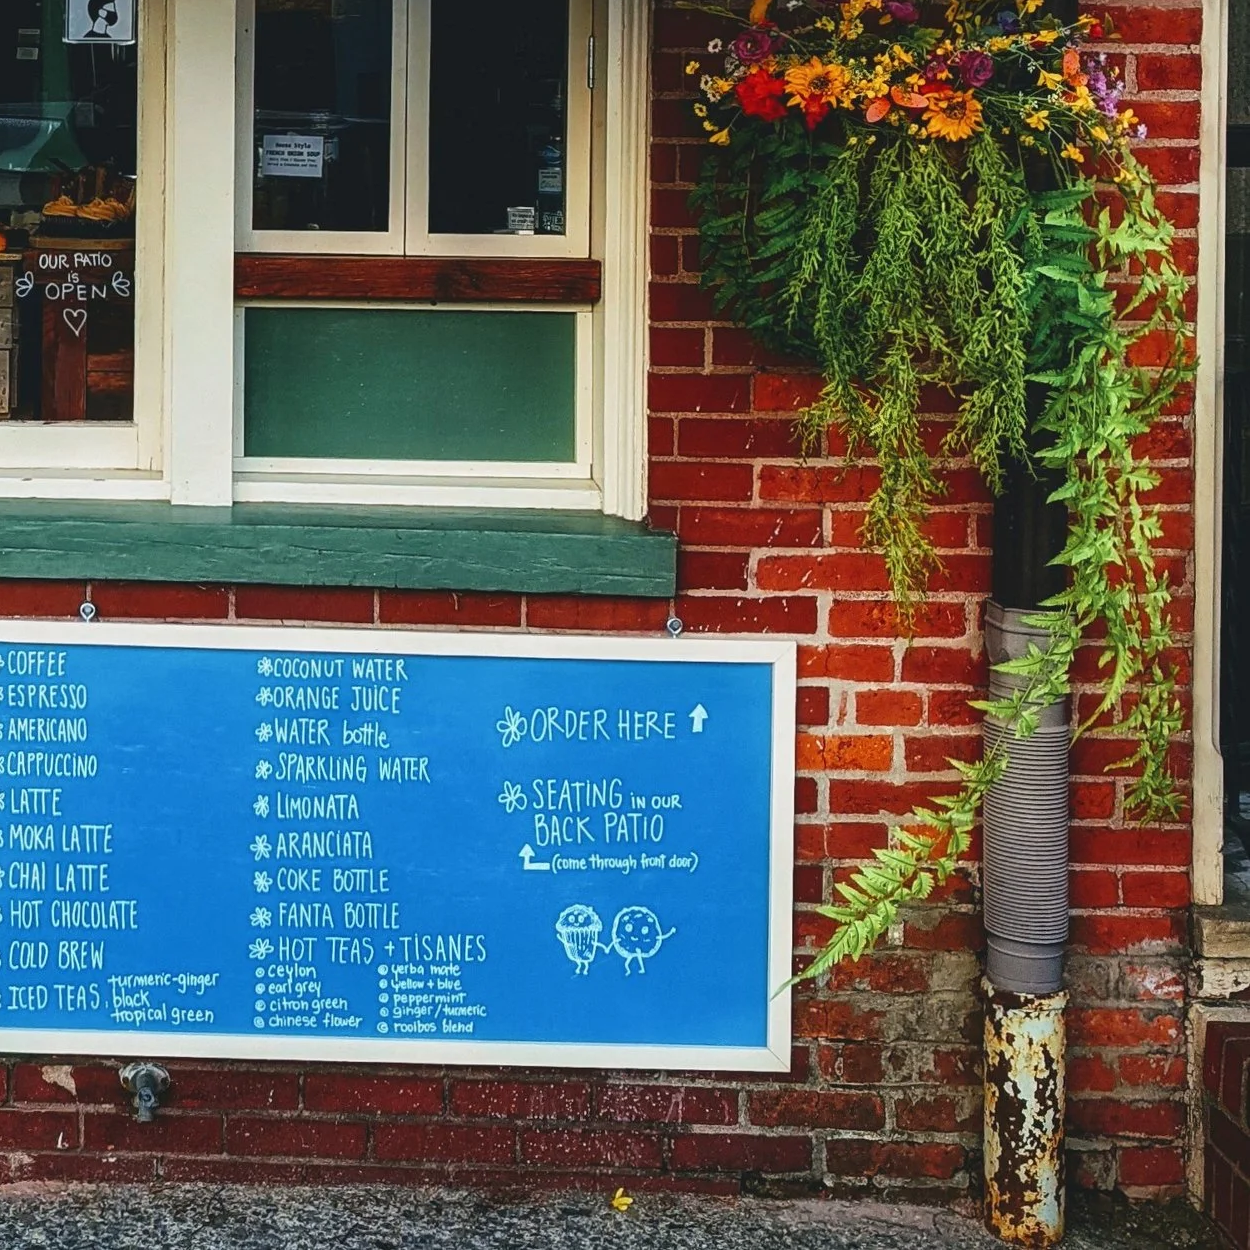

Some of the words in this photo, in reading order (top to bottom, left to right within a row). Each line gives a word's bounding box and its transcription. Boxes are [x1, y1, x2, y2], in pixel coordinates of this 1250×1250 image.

[39, 254, 69, 269] OUR
[45, 283, 107, 300] OPEN
[8, 651, 67, 677] COFFEE
[273, 658, 344, 678] COCONUT
[352, 659, 408, 682] WATER
[8, 684, 87, 709] ESPRESSO
[273, 686, 340, 711] ORANGE
[8, 717, 87, 743] AMERICANO
[274, 717, 331, 746] WATER
[343, 720, 390, 749] bottle
[530, 707, 610, 742] ORDER
[617, 709, 676, 741] HERE
[7, 751, 97, 778] CAPPUCCINO
[275, 752, 367, 784] SPARKLING
[379, 757, 431, 783] WATER
[11, 788, 62, 816] LATTE
[277, 792, 359, 820] LIMONATA
[651, 794, 682, 810] OUR
[9, 824, 55, 851] MOKA
[62, 824, 113, 853] LATTE
[534, 813, 595, 847] BACK
[604, 812, 664, 843] PATIO
[276, 830, 373, 859] ARANCIATA
[9, 861, 46, 892] CHAI
[56, 863, 109, 892] LATTE
[588, 854, 637, 875] through
[640, 853, 666, 869] front
[277, 867, 321, 892] COKE
[333, 868, 389, 893] BOTTLE
[10, 900, 43, 929] HOT
[51, 900, 138, 930] CHOCOLATE
[279, 902, 334, 928] FANTA
[344, 901, 400, 929] BOTTLE
[9, 940, 49, 970] COLD
[58, 940, 104, 971] BREW
[267, 963, 316, 981] ceylon
[391, 964, 424, 980] yerba
[437, 978, 462, 991] blue
[7, 985, 48, 1010] ICED
[294, 981, 321, 998] grey
[393, 992, 467, 1007] peppermint
[110, 1006, 168, 1024] tropical
[171, 1007, 214, 1025] green
[269, 997, 309, 1012] citron
[311, 997, 348, 1014] green
[268, 1015, 317, 1027] chinese
[323, 1012, 363, 1027] flower
[394, 1022, 437, 1033] rooibos
[441, 1021, 474, 1032] blend
